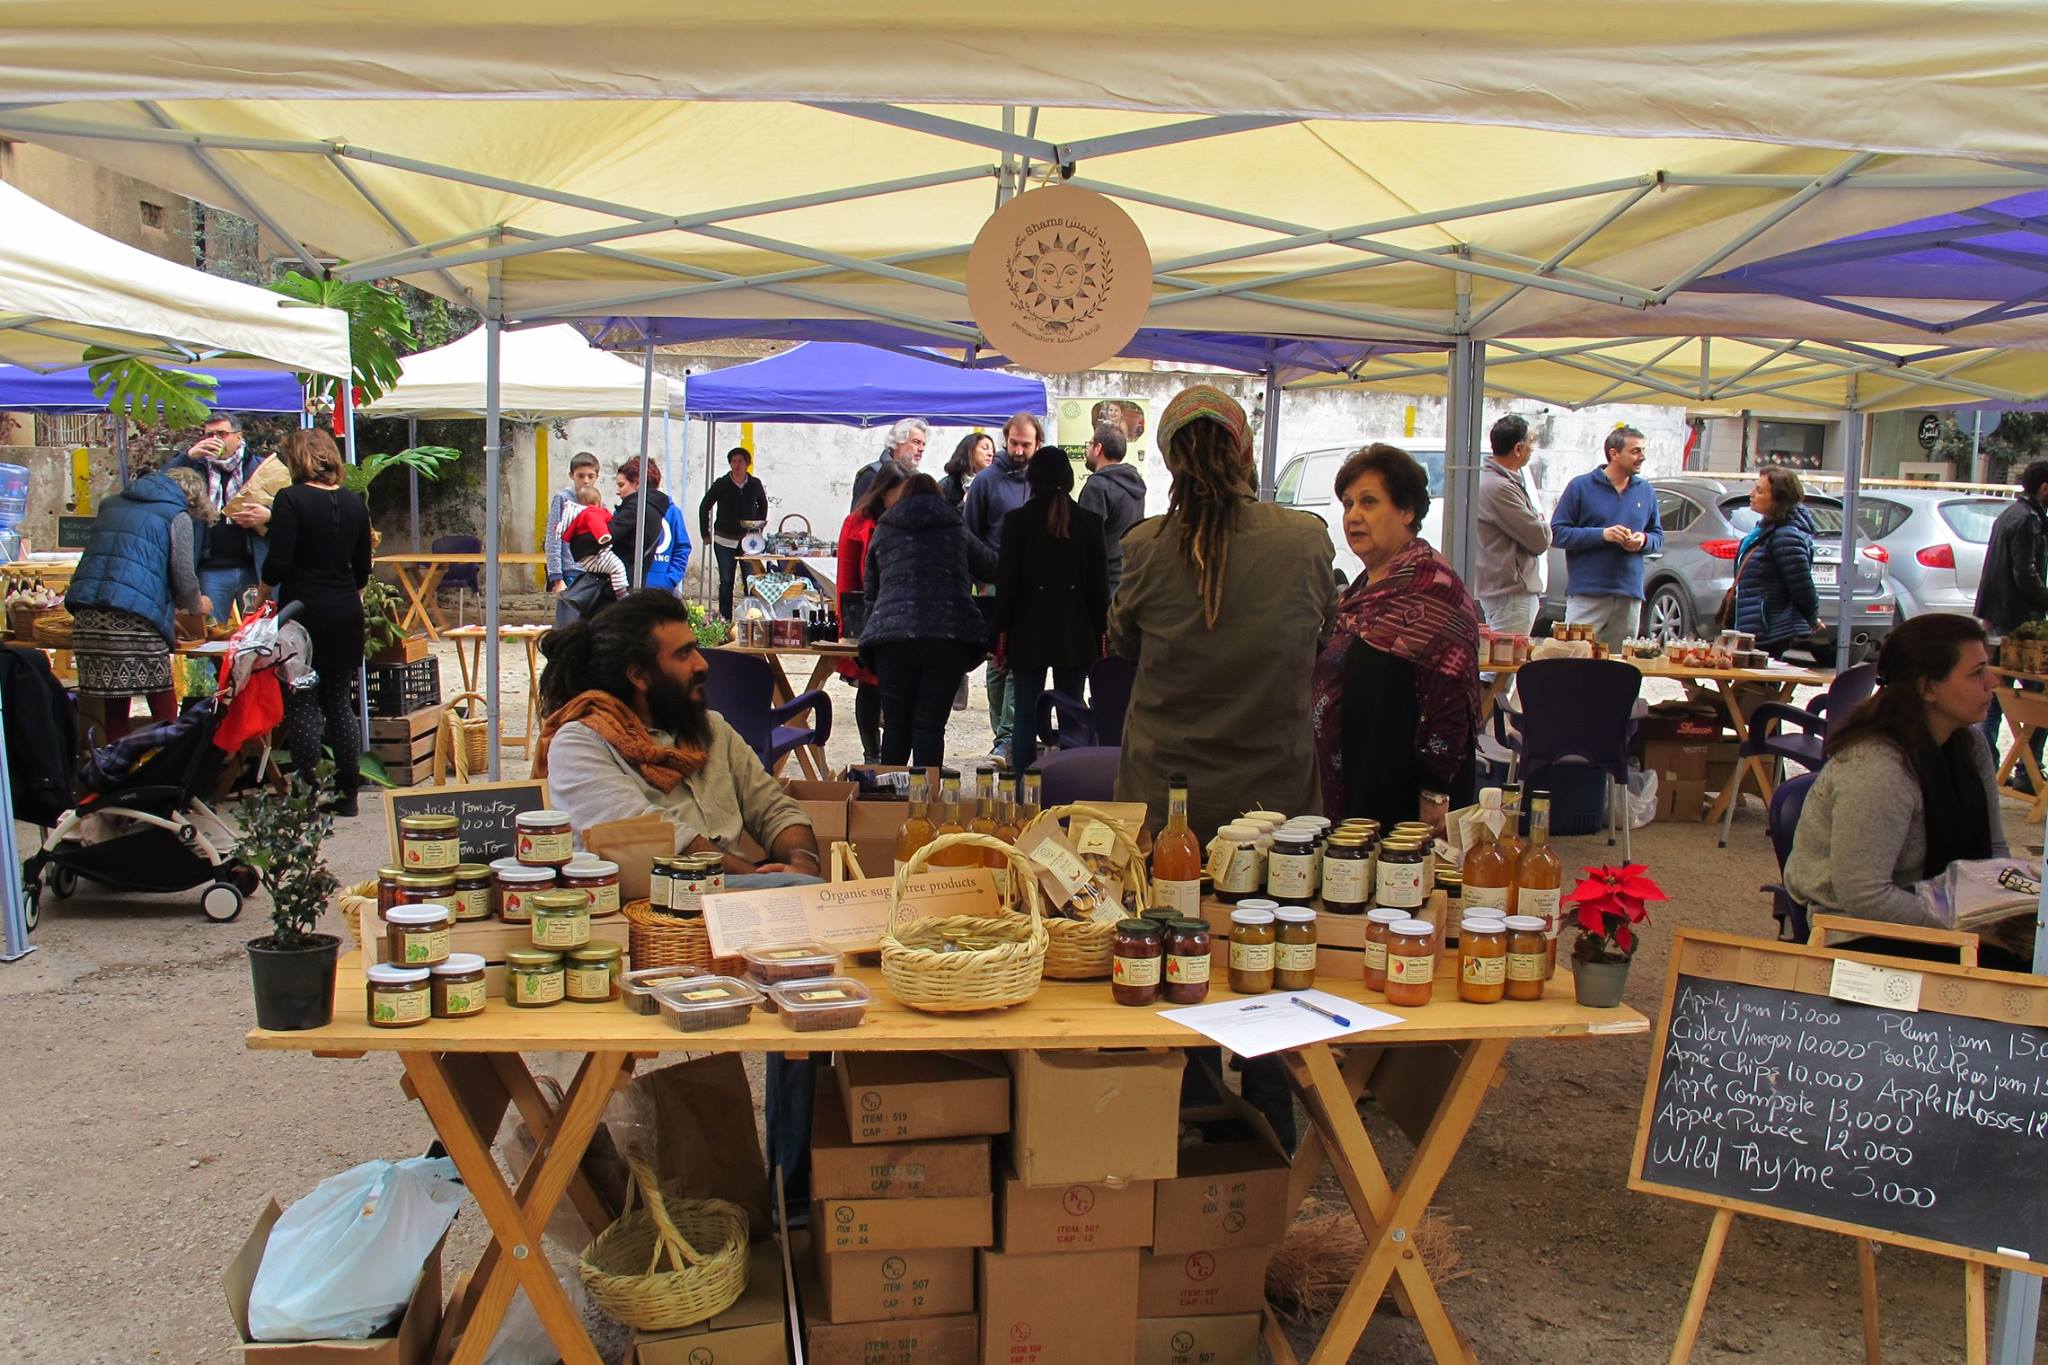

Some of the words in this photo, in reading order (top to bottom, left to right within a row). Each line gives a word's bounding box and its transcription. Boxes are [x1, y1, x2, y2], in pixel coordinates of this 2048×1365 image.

[1025, 217, 1064, 237] Shams
[462, 819, 494, 831] 000
[819, 887, 868, 904] Organic
[929, 877, 976, 895] products
[1679, 986, 1728, 1014] Apple
[1724, 993, 1771, 1023] jam
[1672, 1012, 1729, 1047] Cider
[1731, 1018, 1792, 1065] Vinegar
[1876, 1013, 1939, 1043] Plum
[1719, 1051, 1781, 1091] Chips
[1979, 1064, 2026, 1102] jam
[1664, 1070, 1719, 1103] Apple
[1877, 1077, 1941, 1117] Apple
[897, 1126, 908, 1136] 24
[1657, 1102, 1727, 1132] Apple
[1653, 1135, 1722, 1178] Wild
[1731, 1142, 1835, 1192] Thyme
[912, 1279, 930, 1290] 507
[912, 1296, 925, 1306] 12
